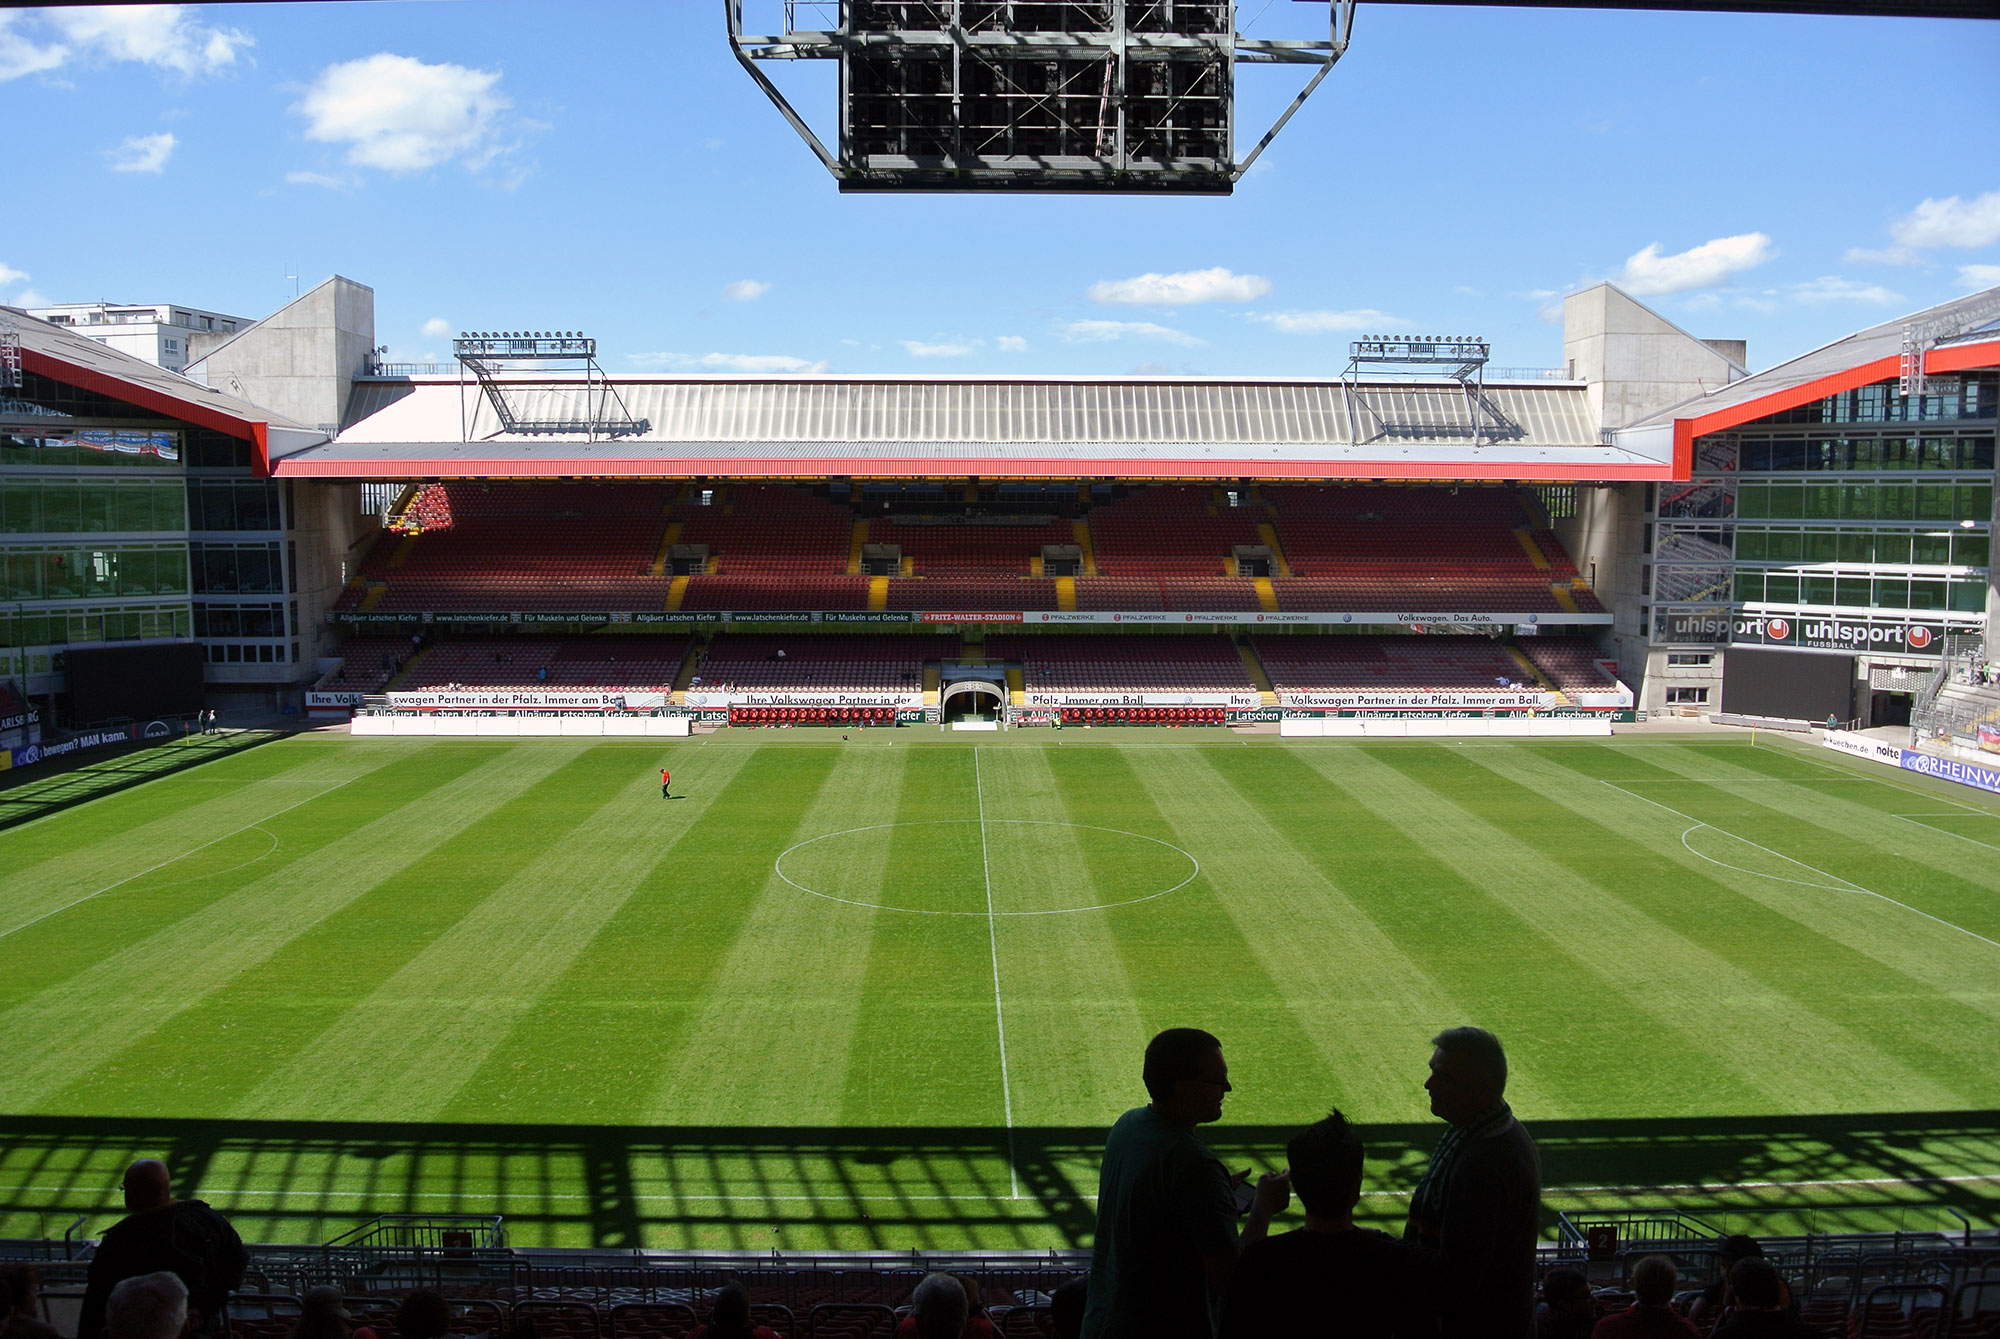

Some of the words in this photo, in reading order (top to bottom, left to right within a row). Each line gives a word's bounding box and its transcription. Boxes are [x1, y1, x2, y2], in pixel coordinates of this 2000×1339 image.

[339, 614, 367, 622] Allgäuer
[524, 613, 535, 621] Für
[537, 613, 565, 621] Muskeln
[567, 613, 579, 621] und
[580, 613, 606, 621] Gelenke
[637, 613, 664, 622] Allgäuer
[666, 613, 694, 621] Latschen
[696, 613, 716, 621] Kiefer
[735, 613, 808, 621] www.latschenkiefer.de
[825, 613, 836, 621] Für
[838, 613, 866, 621] Muskeln
[868, 613, 880, 621] und
[882, 613, 908, 621] Gelenke
[1397, 614, 1449, 624] Volkswagen.
[1453, 614, 1469, 622] Das
[1471, 614, 1493, 622] Auto.
[1675, 616, 1764, 637] uhlsport
[1805, 621, 1903, 644] uhlsport
[1807, 640, 1856, 650] FUSSBALL
[311, 694, 332, 704] Ihre
[334, 694, 358, 704] Volk
[394, 696, 435, 706] swagen
[438, 695, 476, 704] Partner
[479, 695, 488, 704] in
[491, 694, 509, 704] der
[512, 694, 541, 704] Pfalz.
[545, 695, 578, 704] Immer
[581, 696, 599, 704] am
[746, 695, 767, 704] Ihre
[770, 695, 835, 705] Volkswagen
[839, 695, 877, 704] Partner
[880, 695, 891, 704] in
[893, 695, 912, 704] der
[1032, 695, 1061, 704] Pfalz.
[1065, 695, 1099, 704] Immer
[1230, 695, 1251, 704] Ihre
[1290, 695, 1354, 706] Volkswagen
[1357, 695, 1396, 704] Partner
[1398, 695, 1407, 704] in
[1410, 695, 1428, 704] der
[1431, 695, 1460, 704] Pfalz.
[1463, 695, 1496, 704] Immer
[1518, 695, 1541, 704] Ball.
[0, 710, 39, 730] ARLSBRG
[1236, 711, 1279, 720] Latschen
[1282, 711, 1310, 719] Kiefer
[1595, 710, 1623, 720] Kiefer
[80, 733, 100, 748] MAN
[102, 730, 128, 744] kann.
[1876, 745, 1899, 760] nolte
[1598, 1233, 1608, 1248] 2
